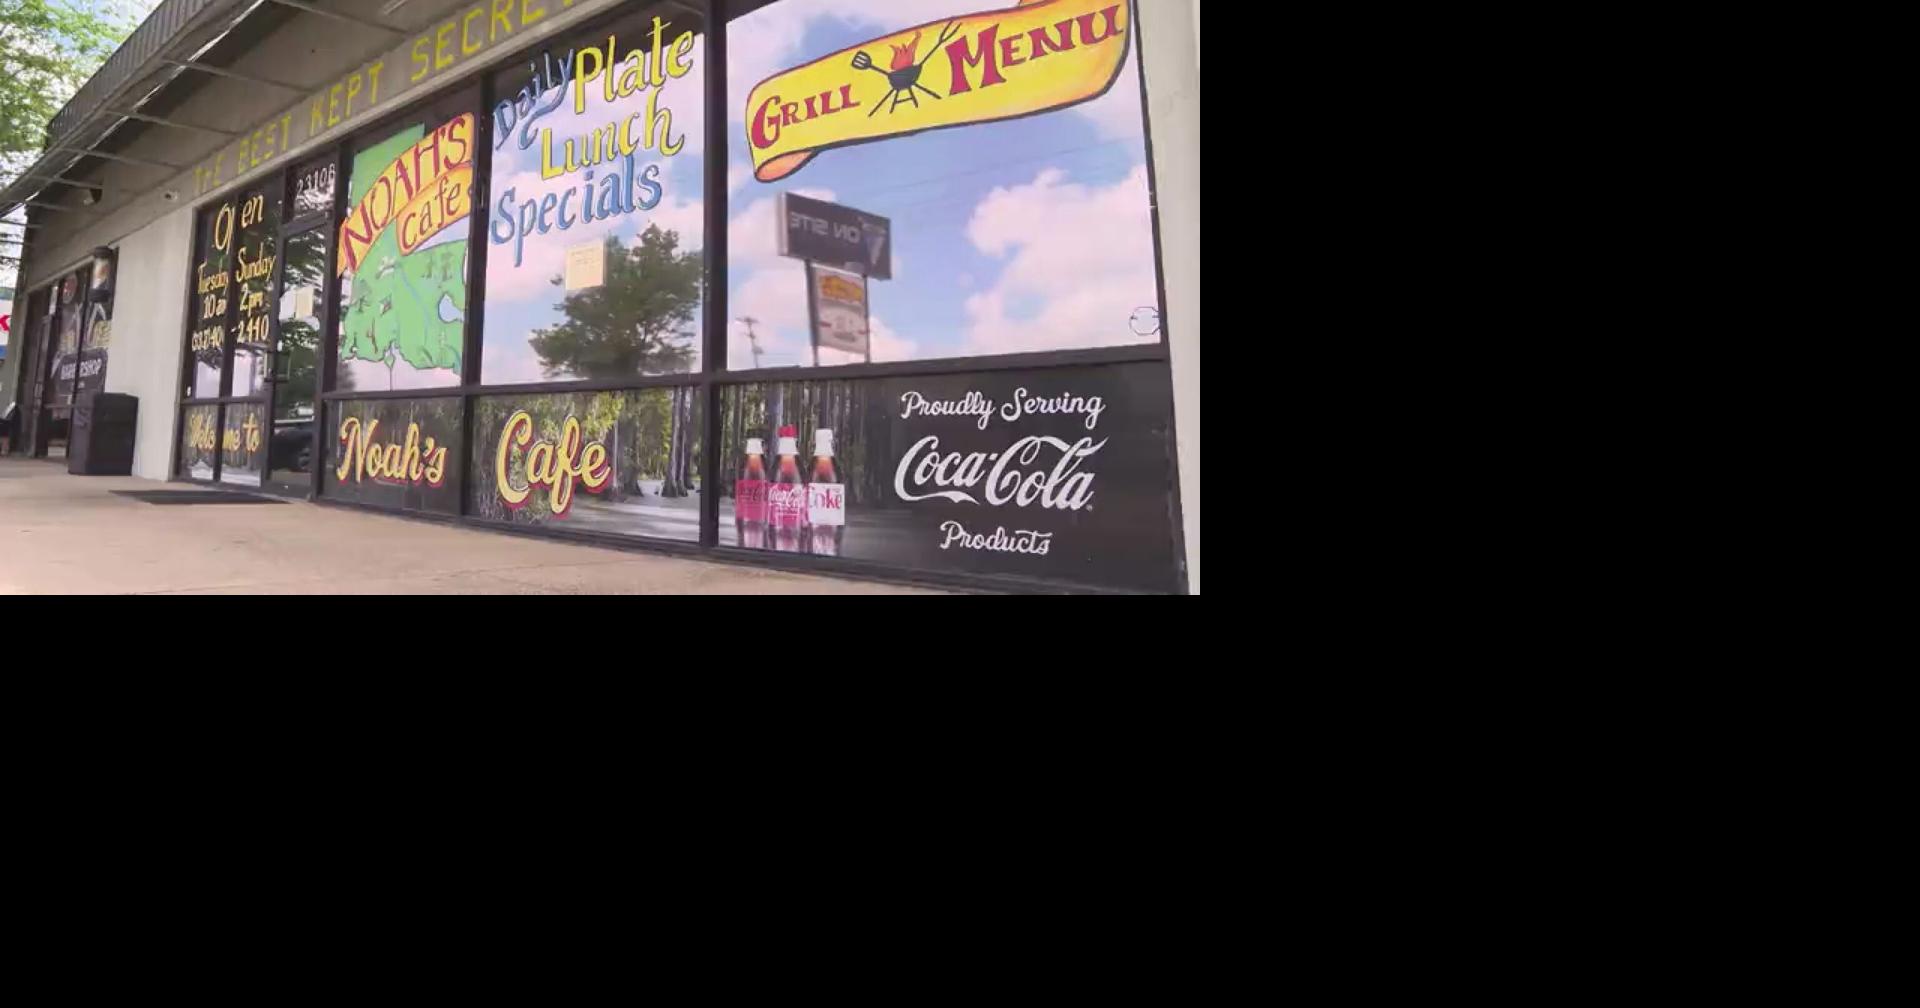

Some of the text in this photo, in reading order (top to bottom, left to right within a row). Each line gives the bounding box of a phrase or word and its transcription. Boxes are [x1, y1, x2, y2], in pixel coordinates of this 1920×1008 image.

[238, 112, 292, 175] BEST
[309, 61, 385, 137] KEPT
[410, 0, 573, 82] SECRE
[493, 16, 695, 151] Daily Plate
[751, 3, 1124, 149] GRILL MENU
[541, 86, 685, 181] Lunch
[214, 195, 264, 255] Oen
[343, 115, 468, 272] NOAH'S
[490, 156, 664, 268] Specials
[236, 242, 276, 283] Sunday
[900, 387, 1106, 430] Proudly Serving
[336, 409, 612, 519] Noah's Cafe
[894, 435, 1109, 512] Coca-Cola
[939, 520, 1053, 555] Products
